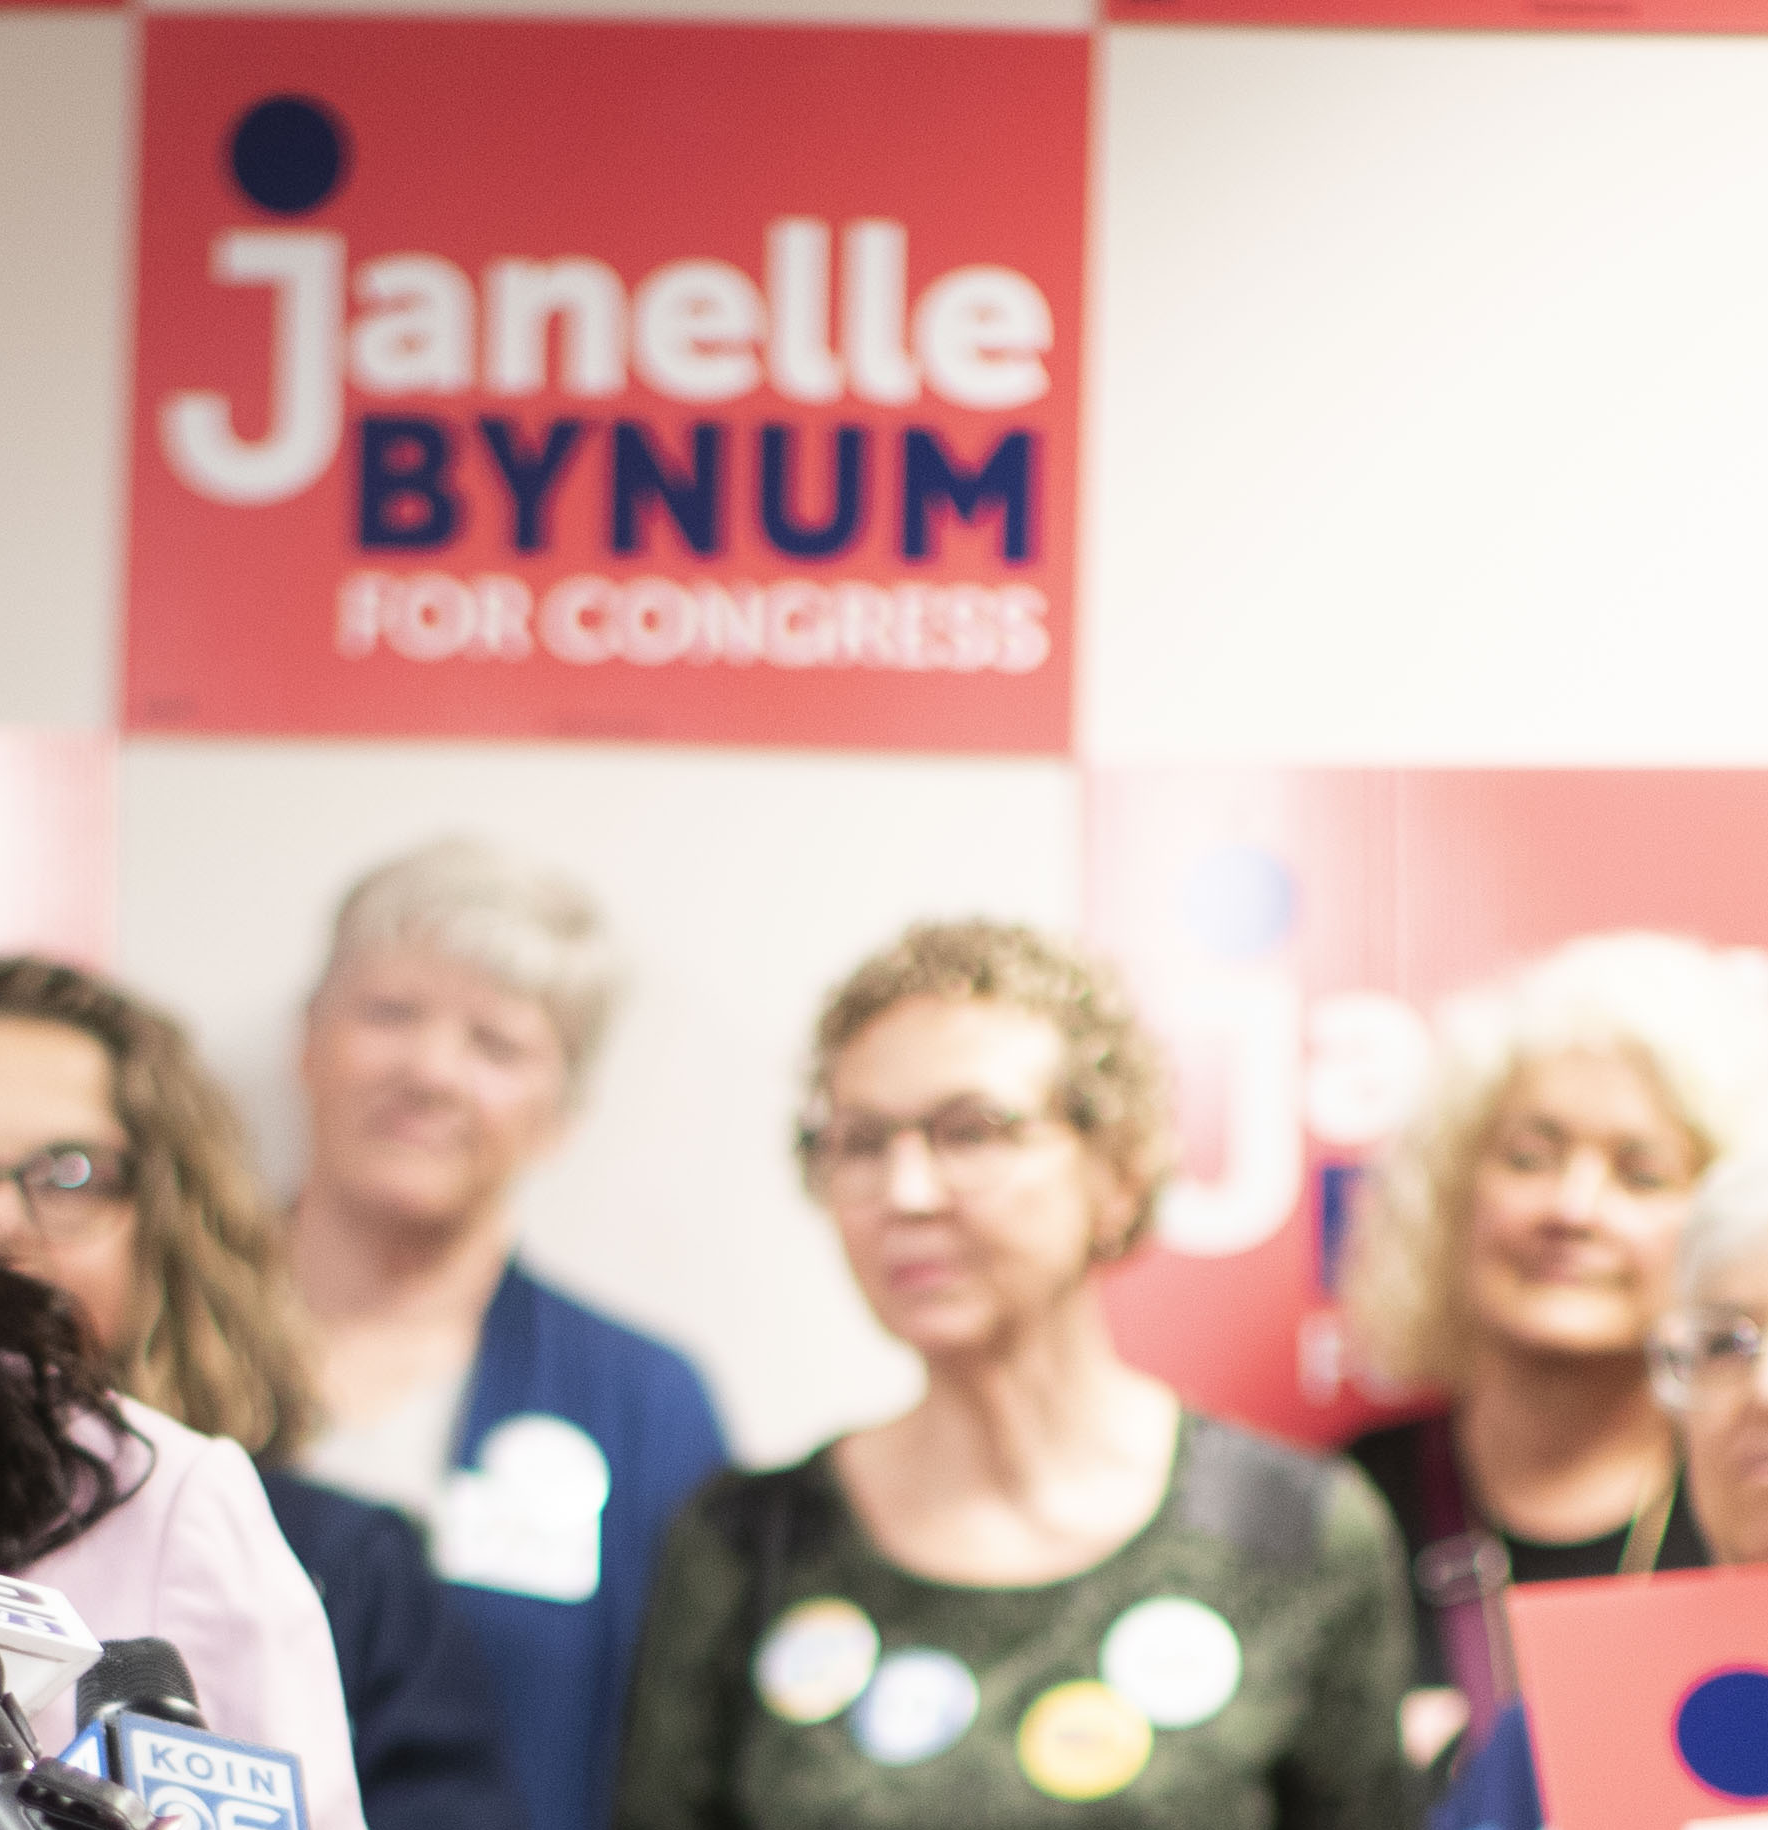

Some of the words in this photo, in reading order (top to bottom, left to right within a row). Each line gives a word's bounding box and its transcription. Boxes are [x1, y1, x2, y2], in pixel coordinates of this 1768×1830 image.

[356, 413, 1039, 563] BYNUM
[338, 572, 534, 663] FOR
[542, 574, 1051, 674] CONGRESS
[149, 1742, 276, 1796] KOIN
